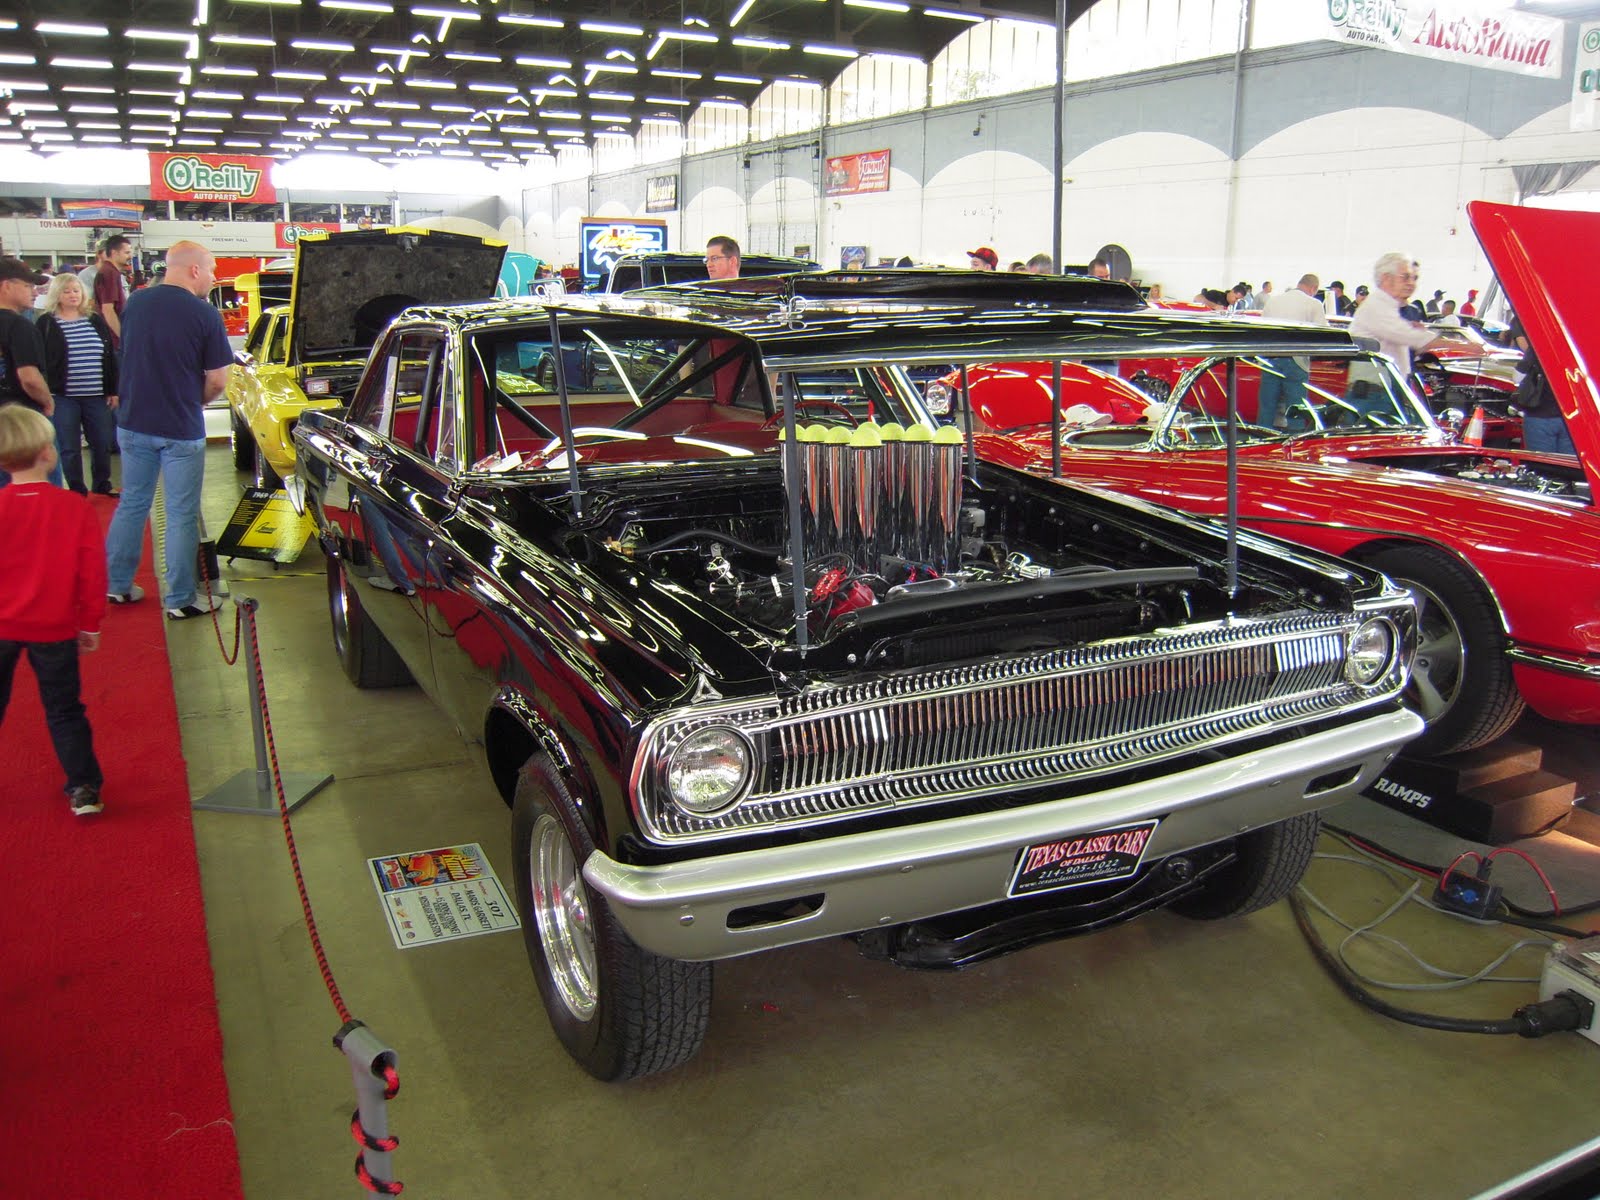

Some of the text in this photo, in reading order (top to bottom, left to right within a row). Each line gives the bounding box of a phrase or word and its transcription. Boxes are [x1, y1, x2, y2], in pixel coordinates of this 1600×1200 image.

[1346, 30, 1365, 40] AUTO
[168, 161, 255, 193] O'Reilly
[1374, 777, 1431, 808] RAMPS
[1022, 828, 1150, 875] TEXAS CLASSIC CARS
[1060, 853, 1107, 867] OF DALLAS
[1038, 859, 1120, 879] 214-905-1022
[485, 899, 504, 918] 307
